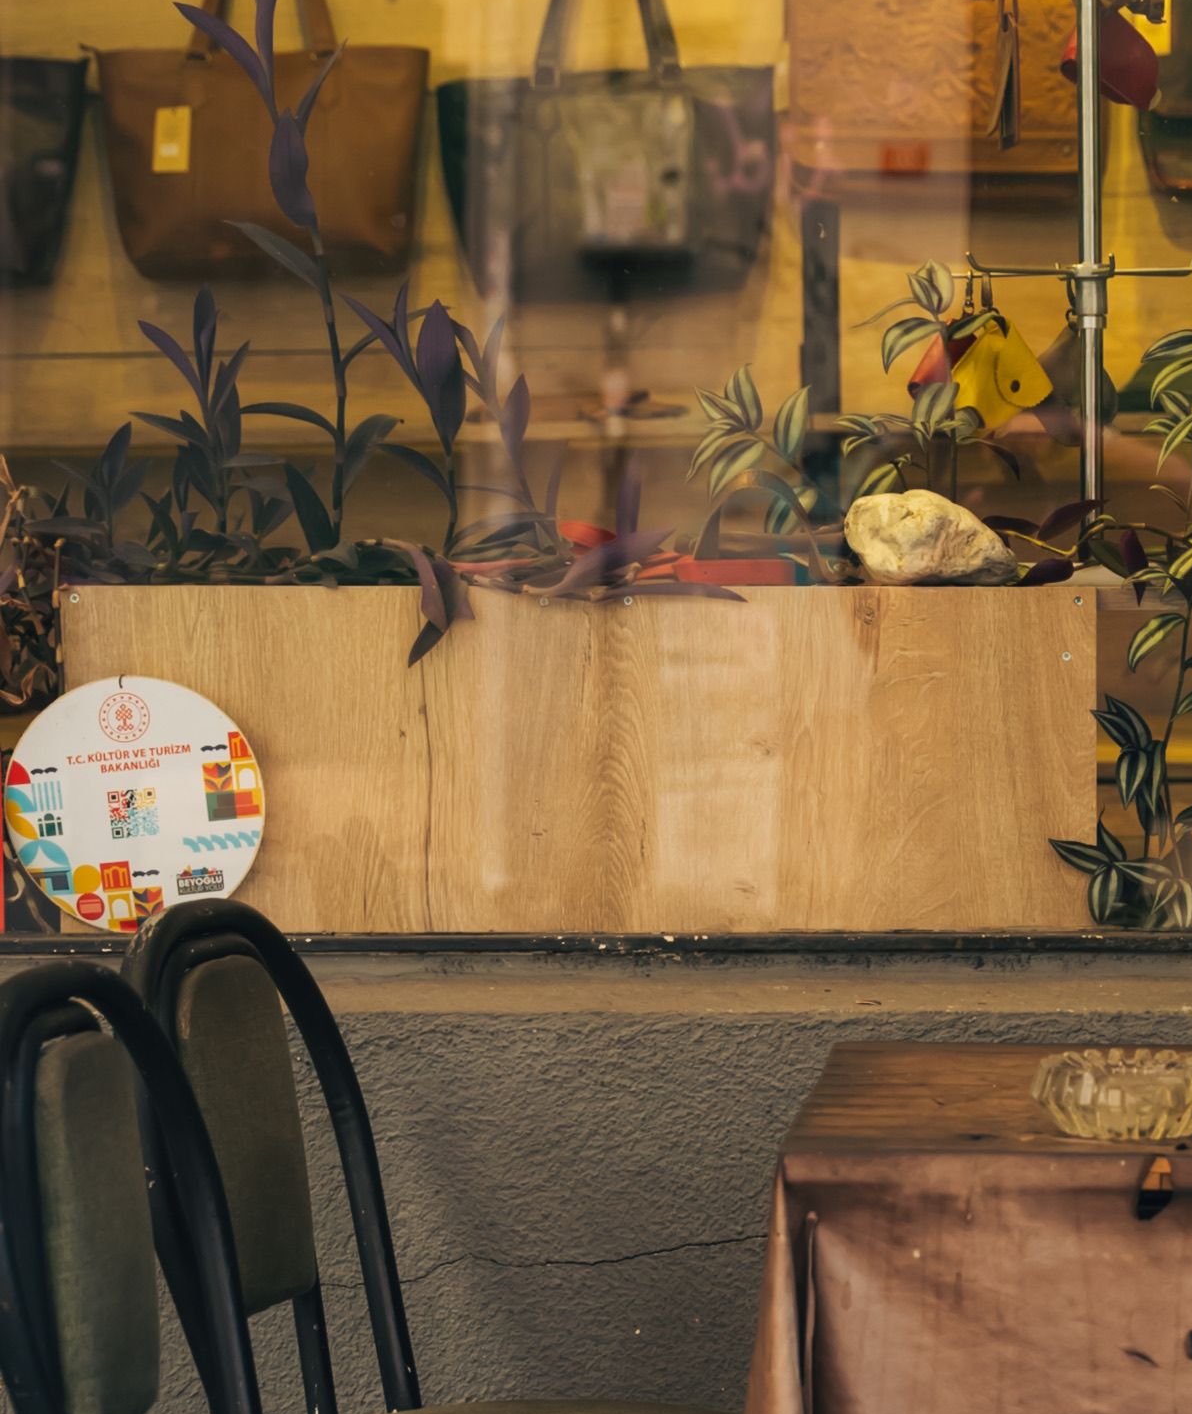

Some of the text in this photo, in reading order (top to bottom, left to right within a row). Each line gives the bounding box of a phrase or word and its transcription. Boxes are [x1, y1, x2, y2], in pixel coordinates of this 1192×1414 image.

[66, 744, 192, 765] T.C. KÜLTÜR VE TURİZM
[100, 758, 161, 774] BAKANLIĞI
